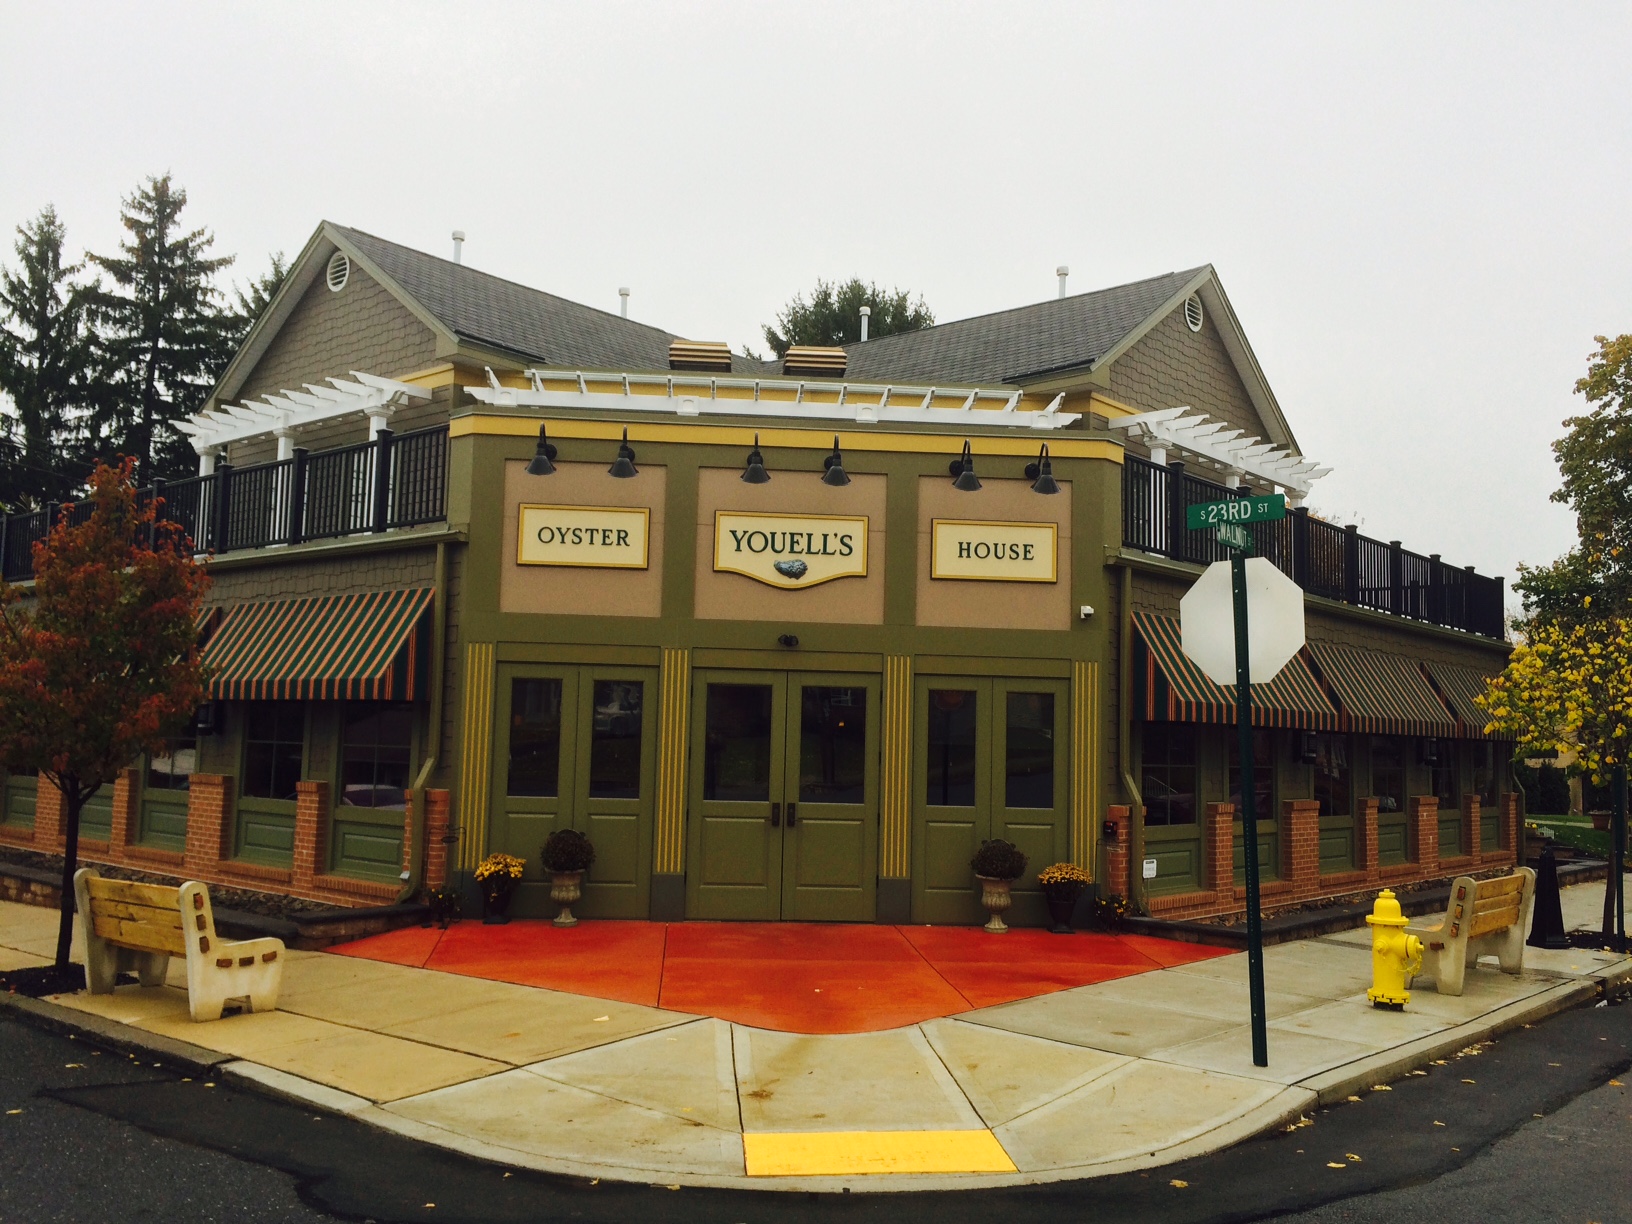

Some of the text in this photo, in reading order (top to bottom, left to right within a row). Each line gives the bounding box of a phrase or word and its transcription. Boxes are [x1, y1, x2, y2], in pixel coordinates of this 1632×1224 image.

[1200, 501, 1268, 522] S 23RD ST
[537, 526, 631, 547] OYSTER
[729, 529, 854, 557] YOUELL'S
[1220, 521, 1247, 548] WALNUT
[957, 541, 1035, 561] HOUSE
